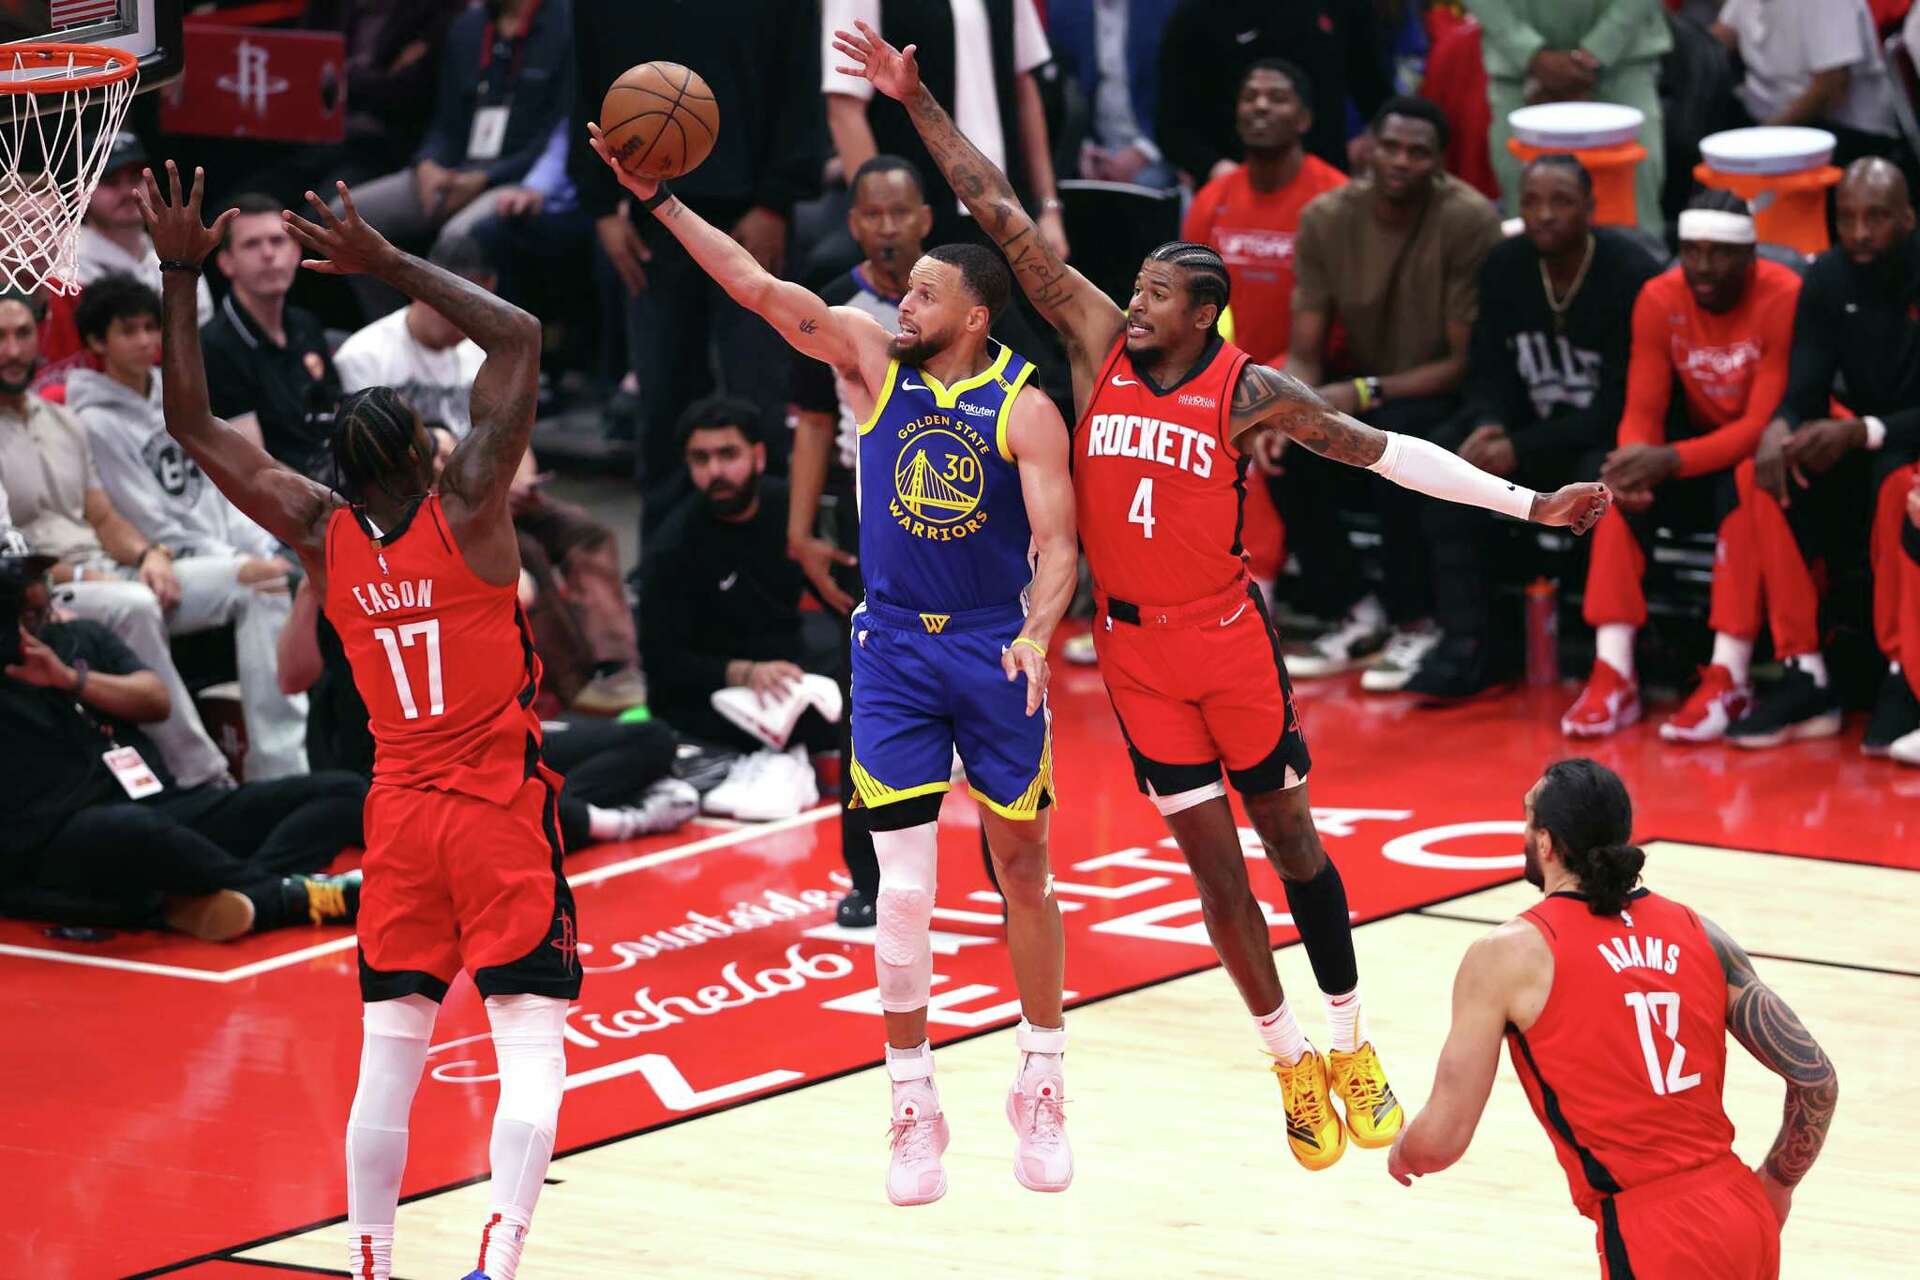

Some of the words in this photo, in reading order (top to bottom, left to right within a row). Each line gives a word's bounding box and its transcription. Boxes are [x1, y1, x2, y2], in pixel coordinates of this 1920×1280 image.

[958, 401, 996, 417] Rakuten
[897, 415, 950, 440] GOLDEN
[954, 420, 990, 455] STATE
[1087, 414, 1217, 479] ROCKETS
[942, 452, 976, 483] 30
[888, 497, 989, 542] WARRIORS
[1127, 477, 1156, 539] 4
[352, 578, 433, 616] EASON
[373, 618, 444, 720] 17
[1597, 935, 1680, 975] ADAMS
[1623, 991, 1701, 1095] 12
